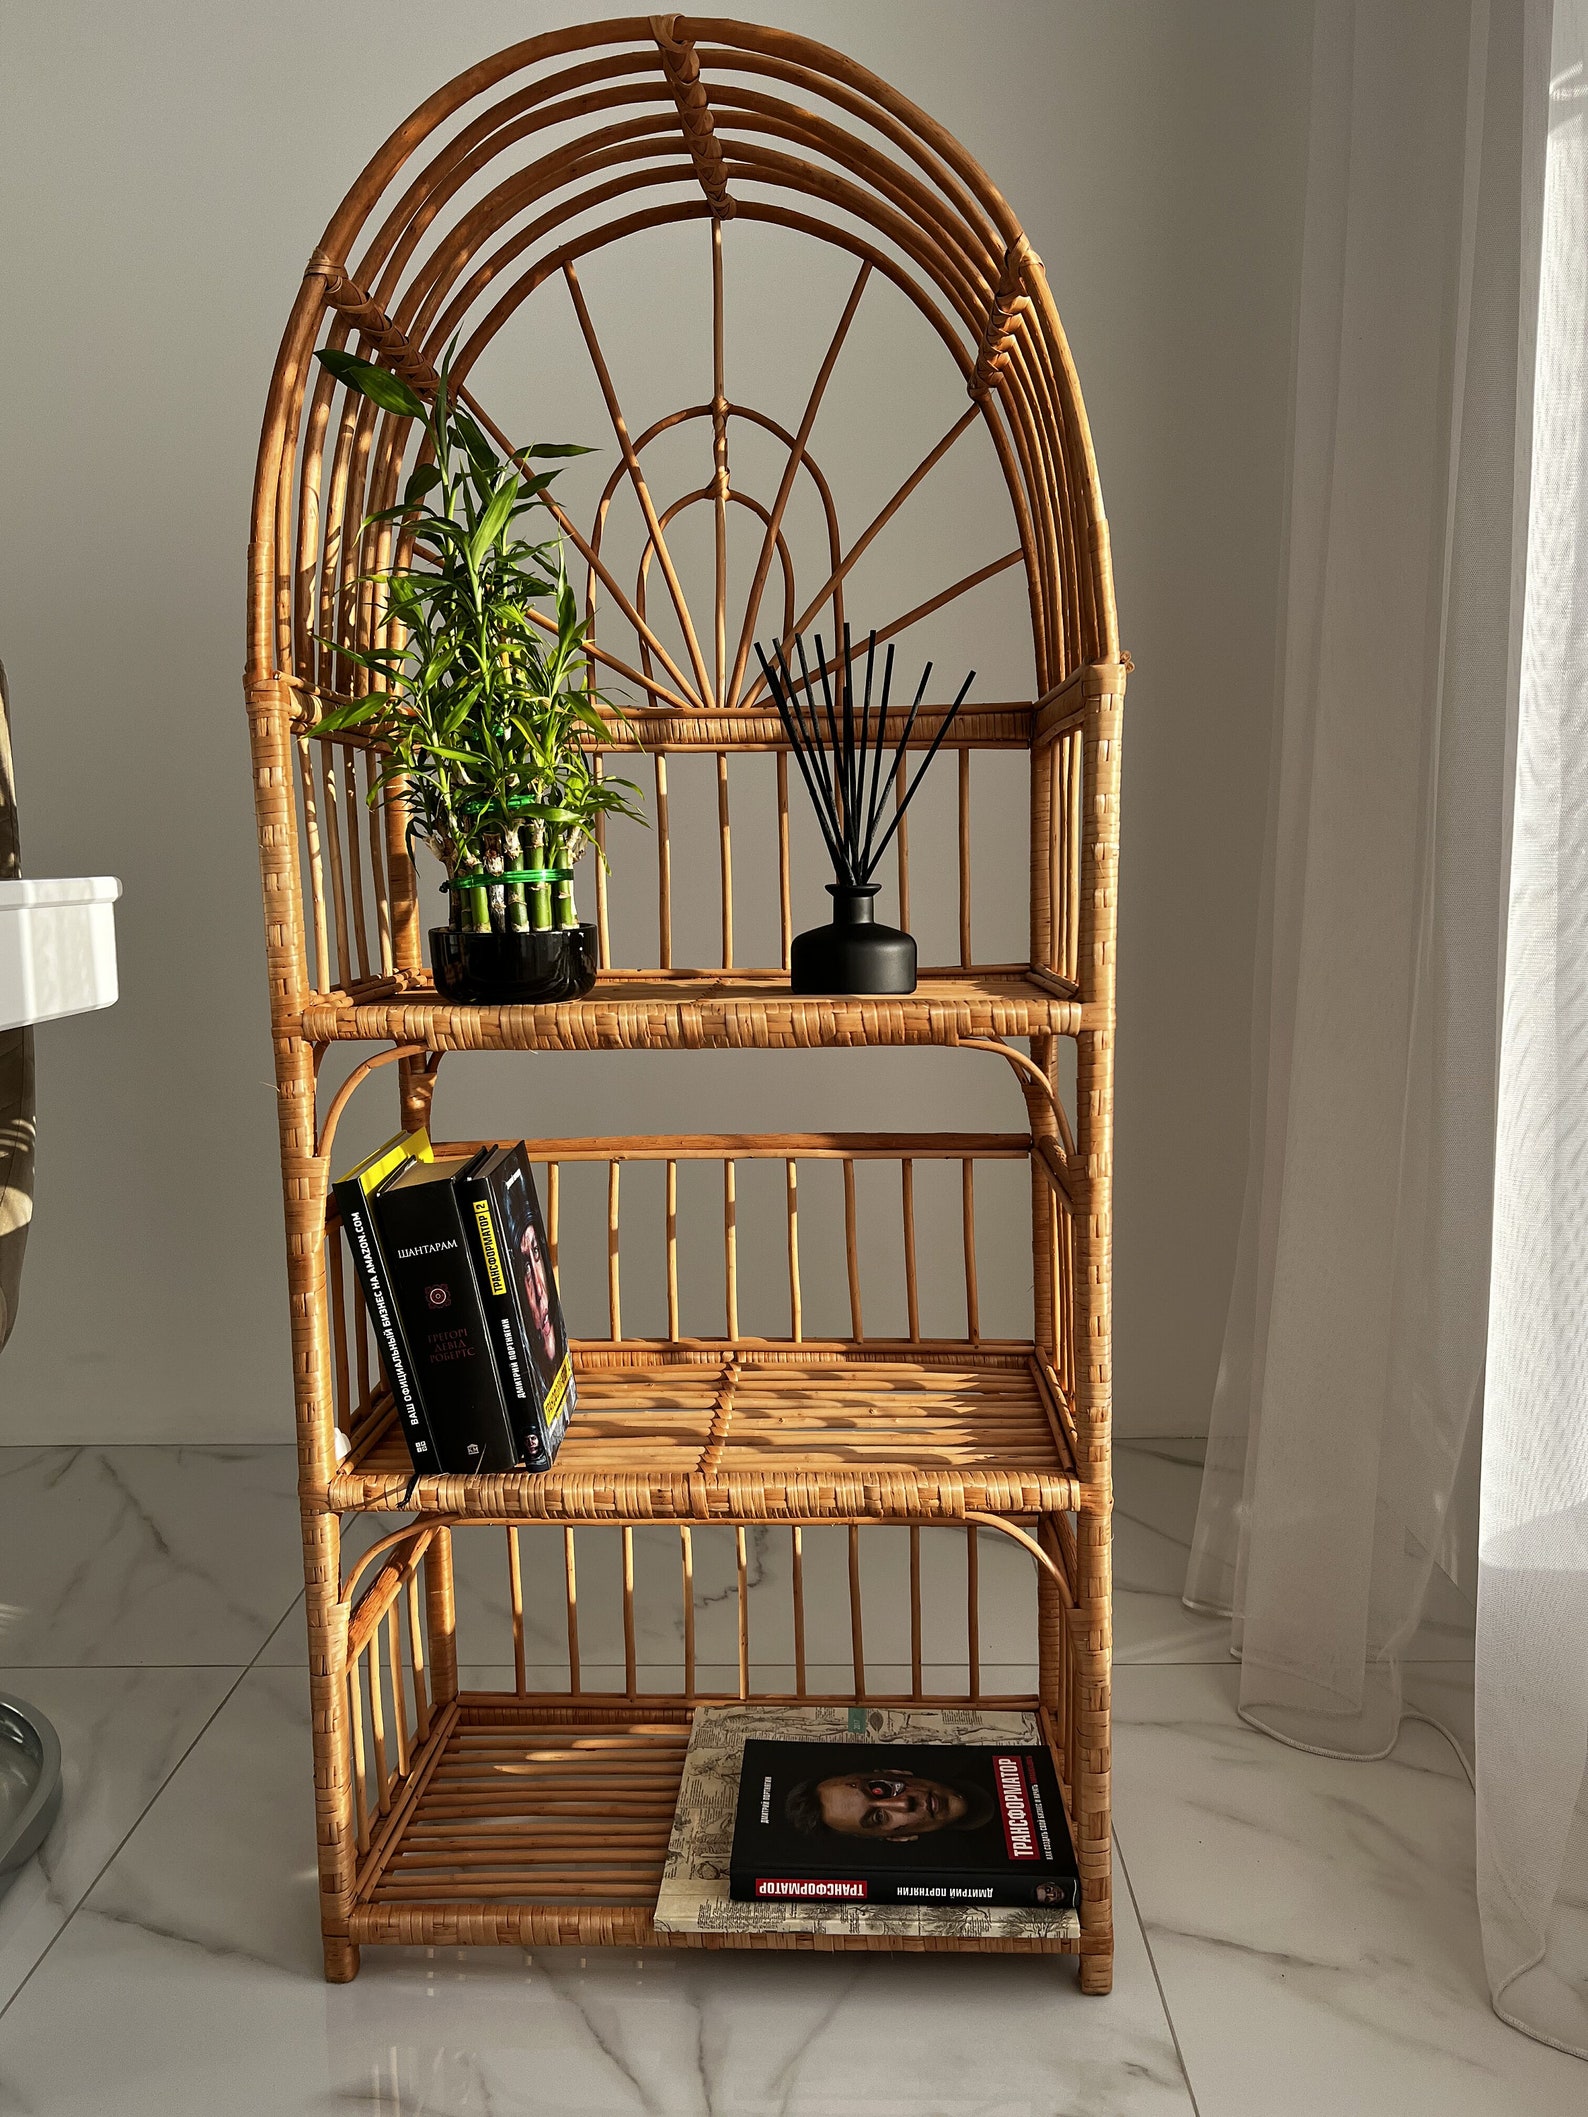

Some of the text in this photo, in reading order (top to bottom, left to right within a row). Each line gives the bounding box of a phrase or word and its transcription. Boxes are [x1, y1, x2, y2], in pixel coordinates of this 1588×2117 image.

[398, 1239, 458, 1259] ШАНТАРАМ
[478, 1215, 503, 1292] ТРАНСФОРМАТОР
[351, 1211, 419, 1426] ВАШ ОФИЦИАЛЬНЫЙ БИЗНЕС НА AMAZON.COM
[429, 1347, 477, 1364] РОБЕРТС
[434, 1339, 467, 1353] ДЕВІД
[501, 1318, 526, 1399] ДМИТРИЙ ПОРТНЯГИН
[998, 1758, 1034, 1856] ТРАНСФОРМАТОР
[759, 1882, 864, 1897] ТРАНСФОРМАТОР
[897, 1886, 994, 1899] ДМИТРИЙ ПОРТНЯГИН
